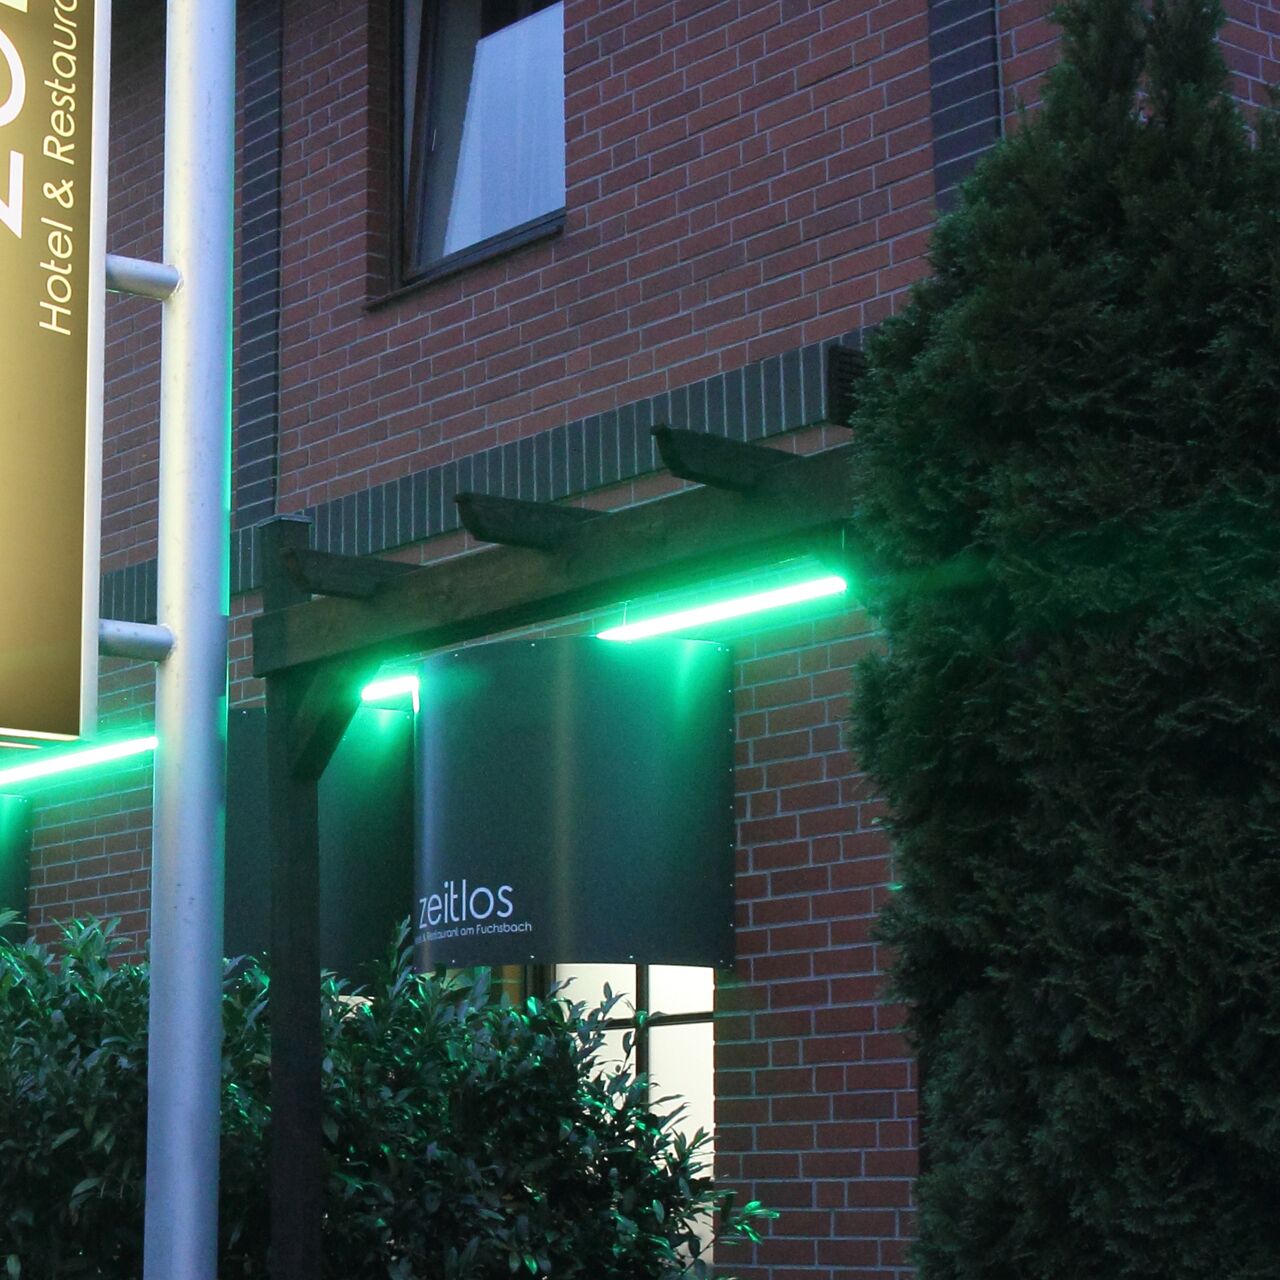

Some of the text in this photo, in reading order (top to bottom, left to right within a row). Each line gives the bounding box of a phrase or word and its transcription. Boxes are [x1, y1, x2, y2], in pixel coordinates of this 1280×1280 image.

[42, 179, 76, 211] &
[39, 217, 73, 336] Hotel
[418, 879, 514, 929] zeitlos
[460, 927, 474, 937] am
[476, 921, 533, 935] Fuchsbach
